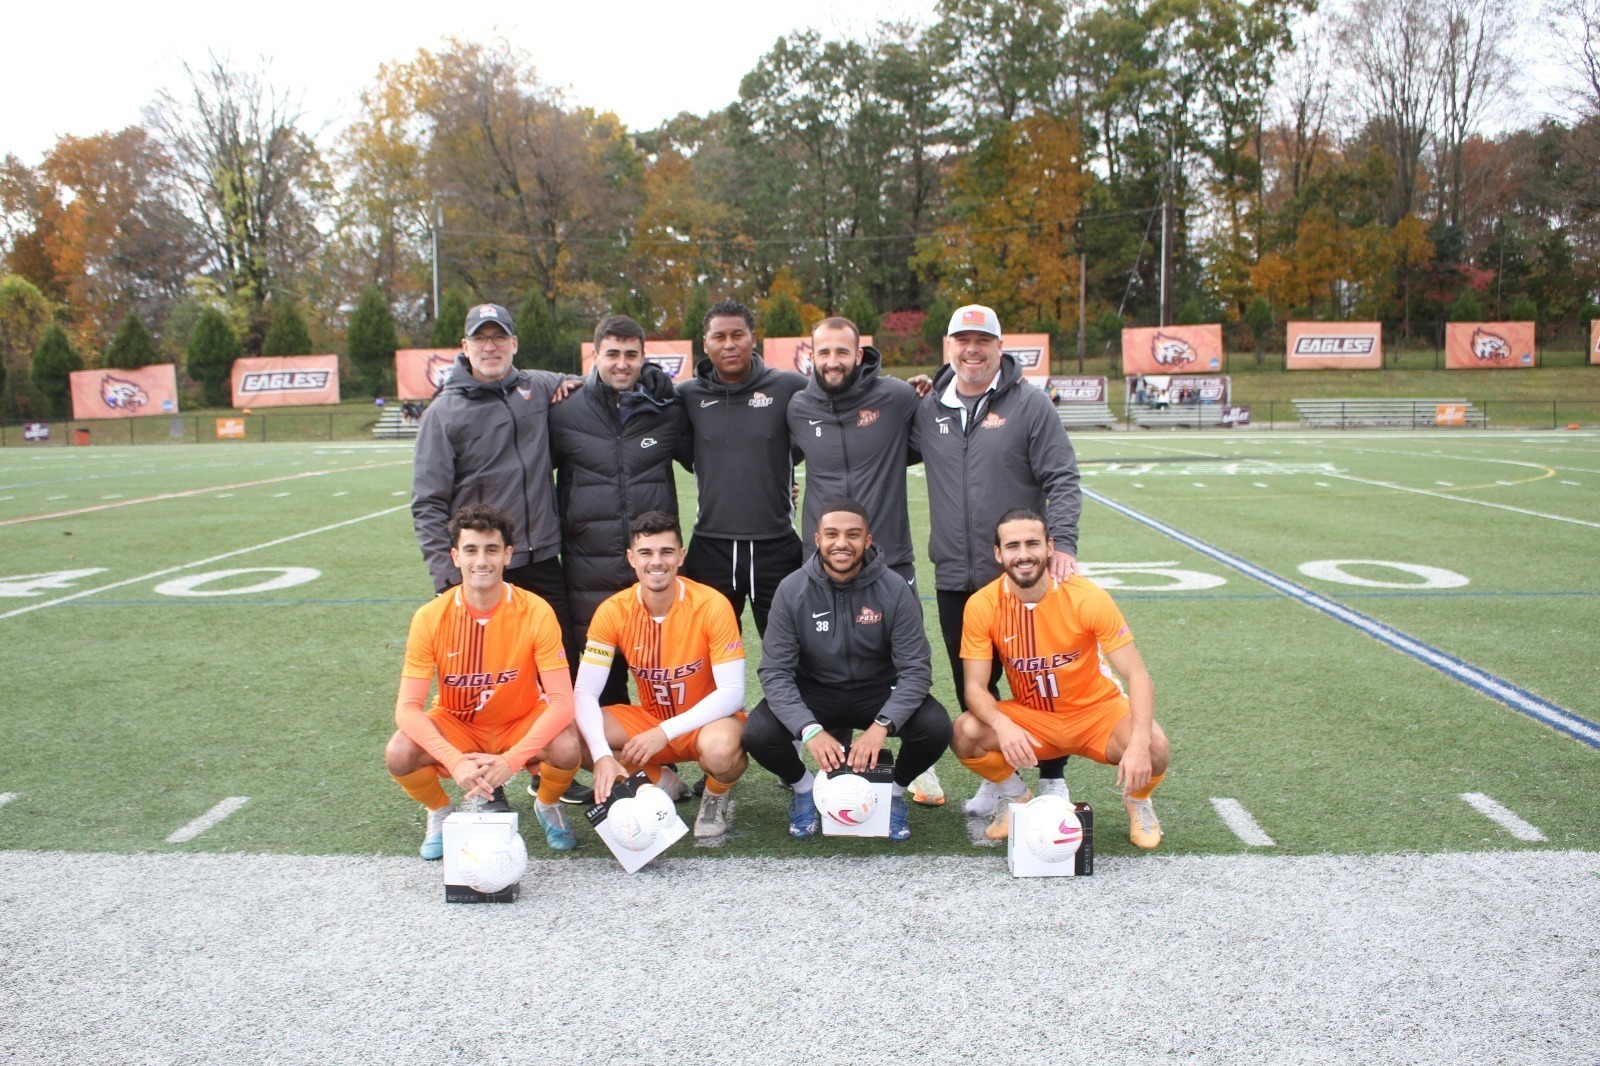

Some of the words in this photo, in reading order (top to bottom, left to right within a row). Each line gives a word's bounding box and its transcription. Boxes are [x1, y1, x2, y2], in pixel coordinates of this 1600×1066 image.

[1298, 338, 1372, 353] EAGLES
[244, 372, 327, 391] EAGLES
[1084, 379, 1098, 387] THE
[1207, 379, 1220, 387] THE
[1056, 389, 1097, 398] AGLES
[816, 427, 821, 437] 8
[939, 424, 949, 434] TH
[816, 621, 829, 632] 38
[1036, 673, 1059, 698] 11
[653, 682, 685, 706] 27
